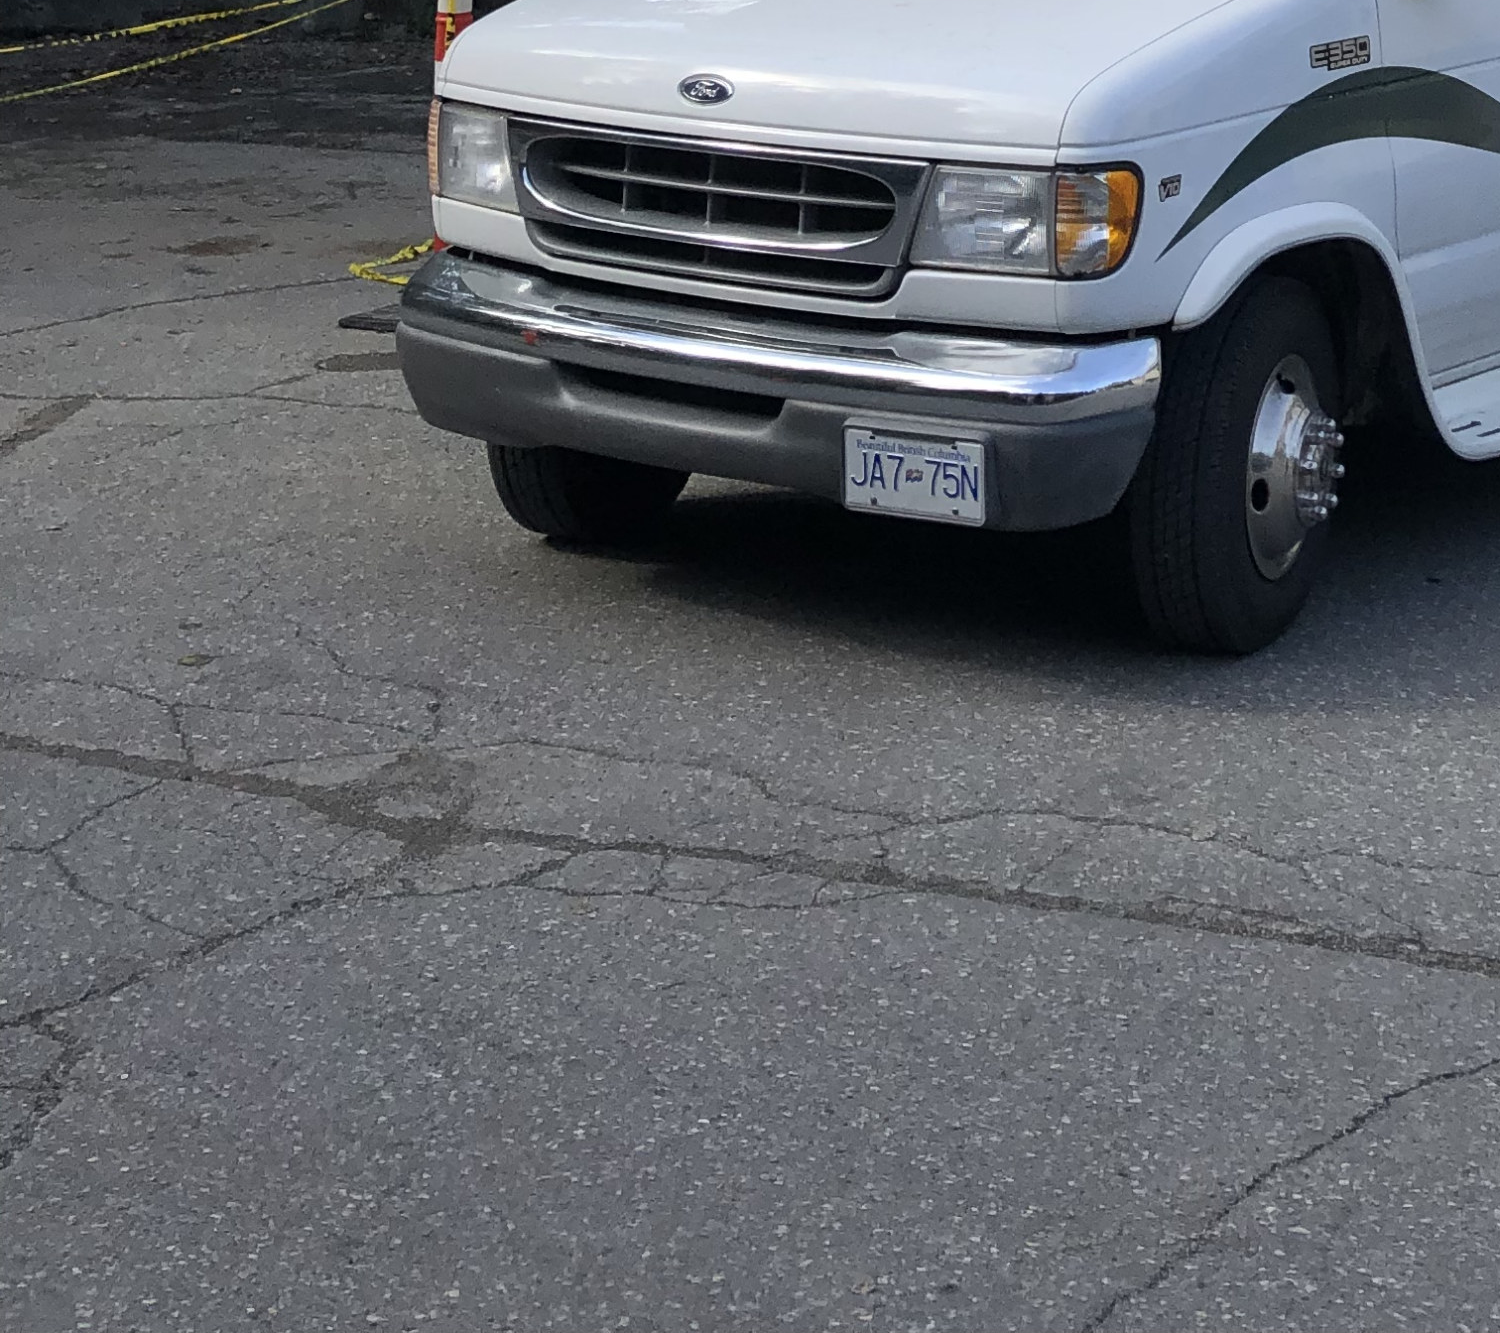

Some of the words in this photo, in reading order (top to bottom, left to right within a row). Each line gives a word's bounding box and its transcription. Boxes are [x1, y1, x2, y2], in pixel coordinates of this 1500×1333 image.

[690, 81, 720, 97] Ford
[1159, 182, 1180, 201] V10
[851, 452, 905, 492] JA7
[925, 458, 979, 502] 75N
